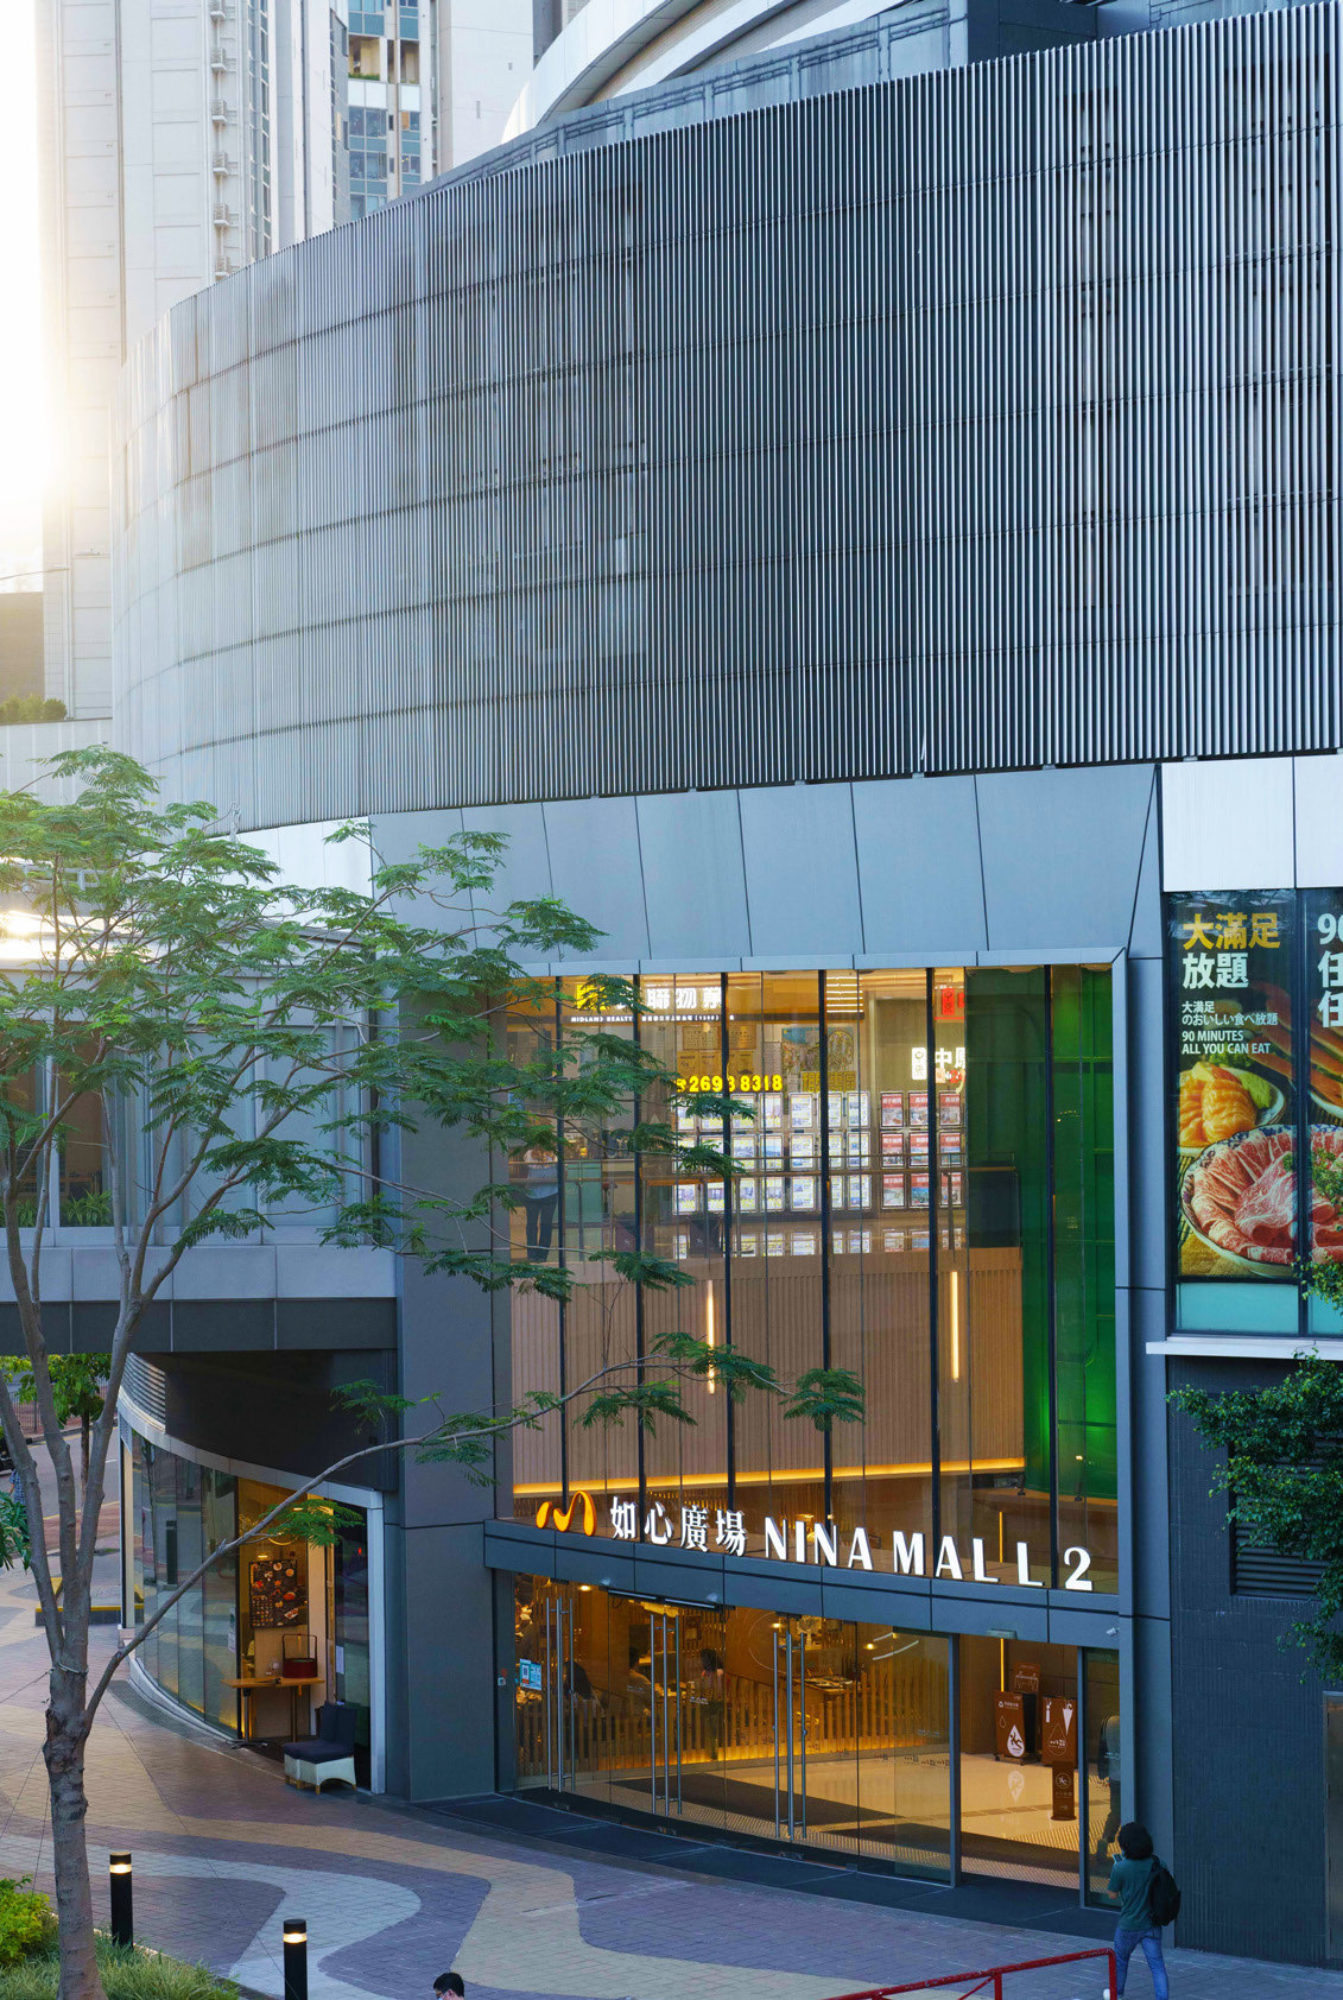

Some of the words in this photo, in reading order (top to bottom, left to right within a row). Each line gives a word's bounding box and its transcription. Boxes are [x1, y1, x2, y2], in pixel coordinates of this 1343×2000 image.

[1183, 912, 1281, 950] 大滿足
[1317, 913, 1343, 945] 9
[1182, 952, 1249, 989] 放題
[1181, 1001, 1215, 1013] 大滿足
[1181, 1031, 1195, 1042] 90
[1197, 1030, 1244, 1042] MINUTES
[1181, 1043, 1200, 1055] ALL
[1202, 1043, 1225, 1055] YOU
[1227, 1043, 1249, 1055] CAN
[1251, 1043, 1271, 1054] EAT
[740, 1074, 783, 1092] 8318
[610, 1496, 747, 1557] 如心廣場
[765, 1516, 874, 1571] NINA
[893, 1530, 1045, 1586] MALL
[1063, 1546, 1094, 1591] 2
